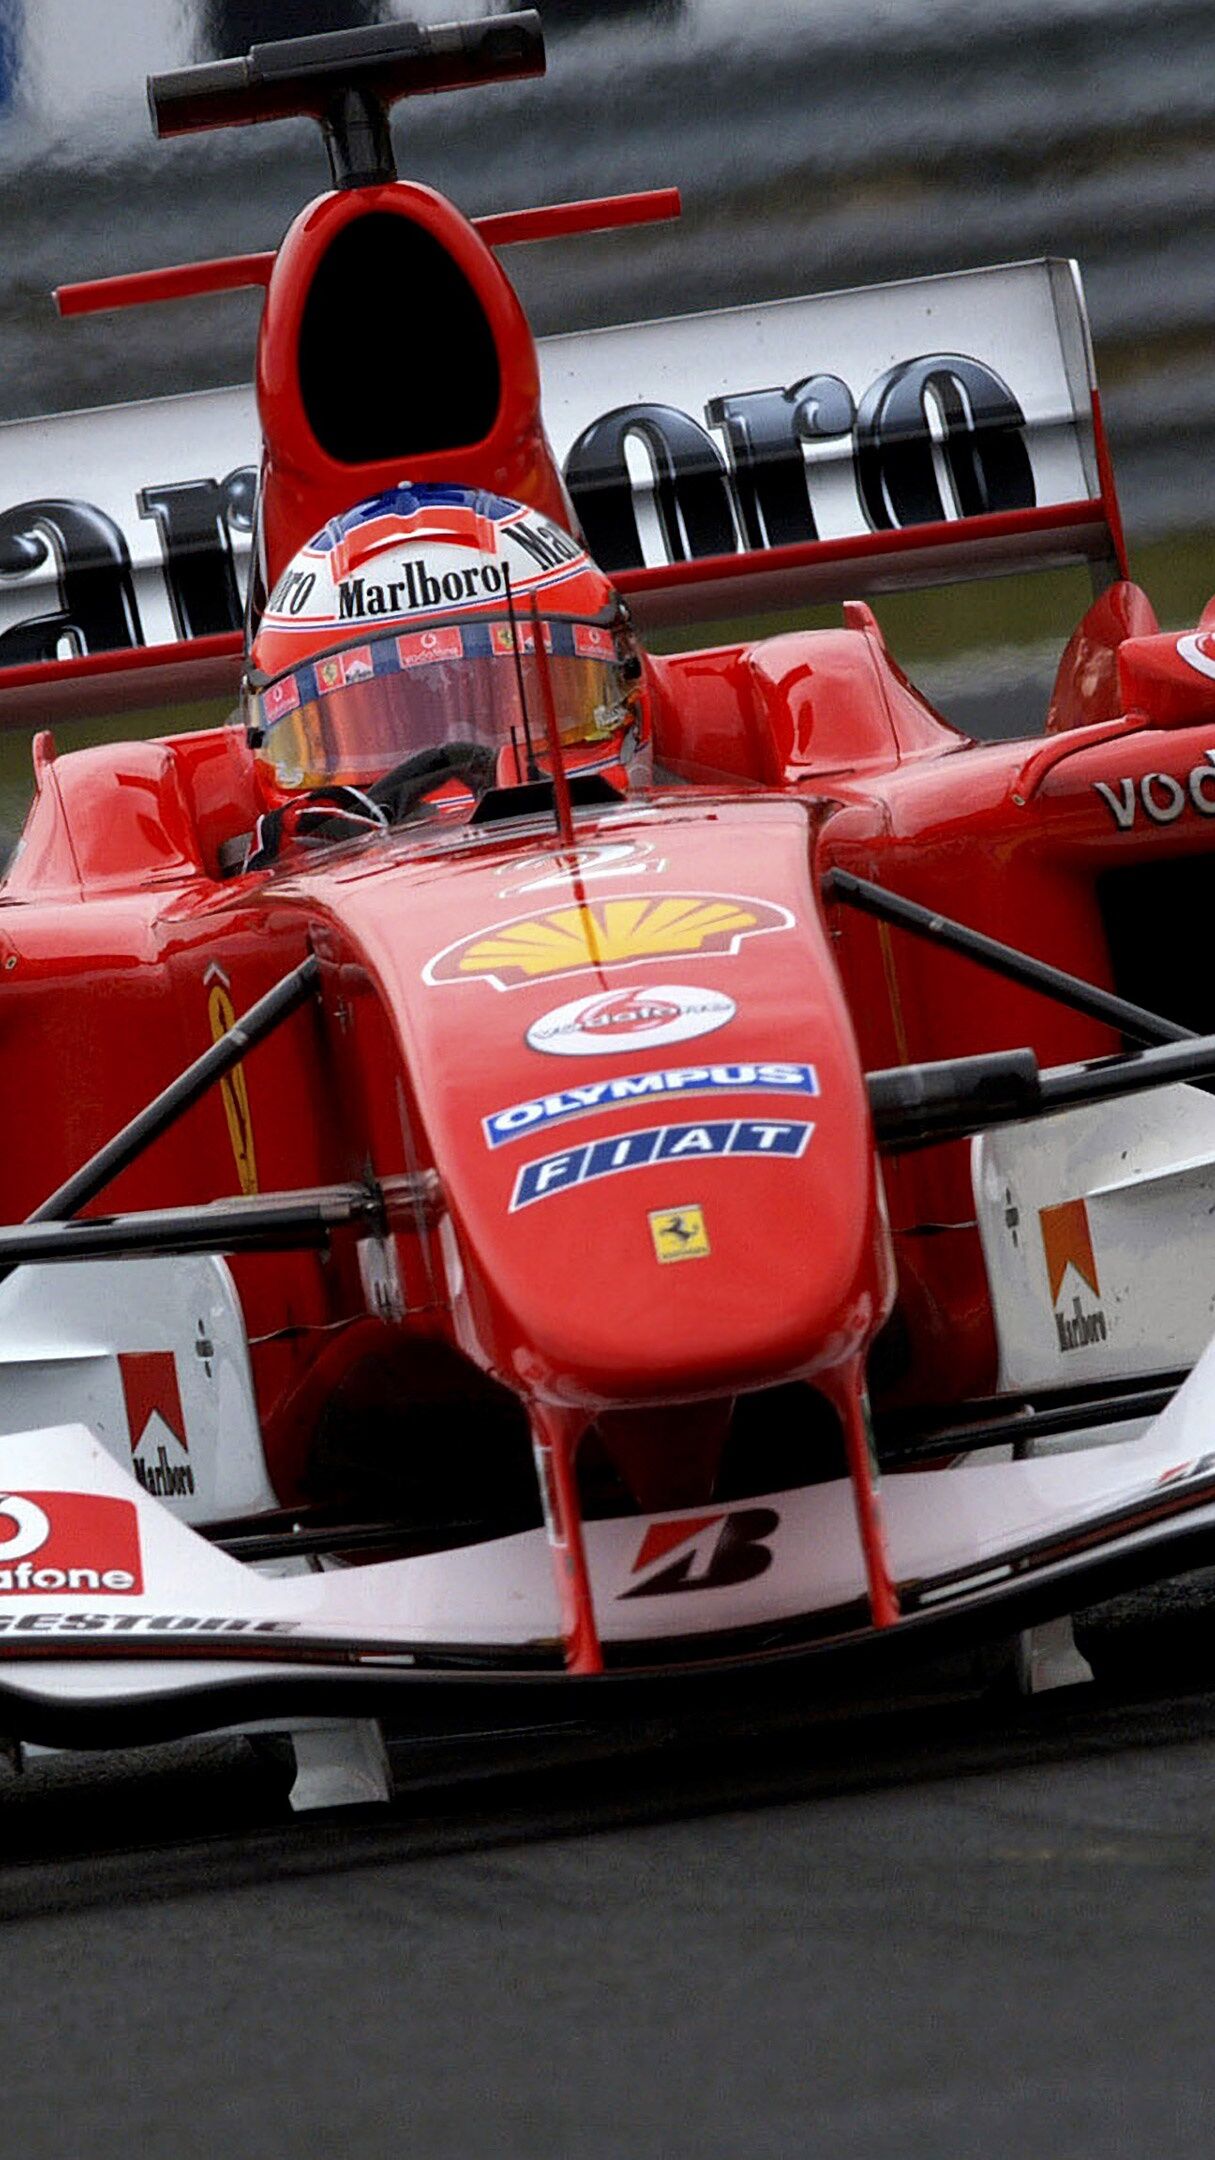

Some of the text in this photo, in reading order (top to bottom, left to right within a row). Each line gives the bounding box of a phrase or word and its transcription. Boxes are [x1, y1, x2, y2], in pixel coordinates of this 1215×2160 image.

[338, 559, 500, 620] Marlboro
[495, 840, 668, 898] 2
[493, 1065, 806, 1131] OLYMPUS
[534, 1125, 791, 1192] FIAT
